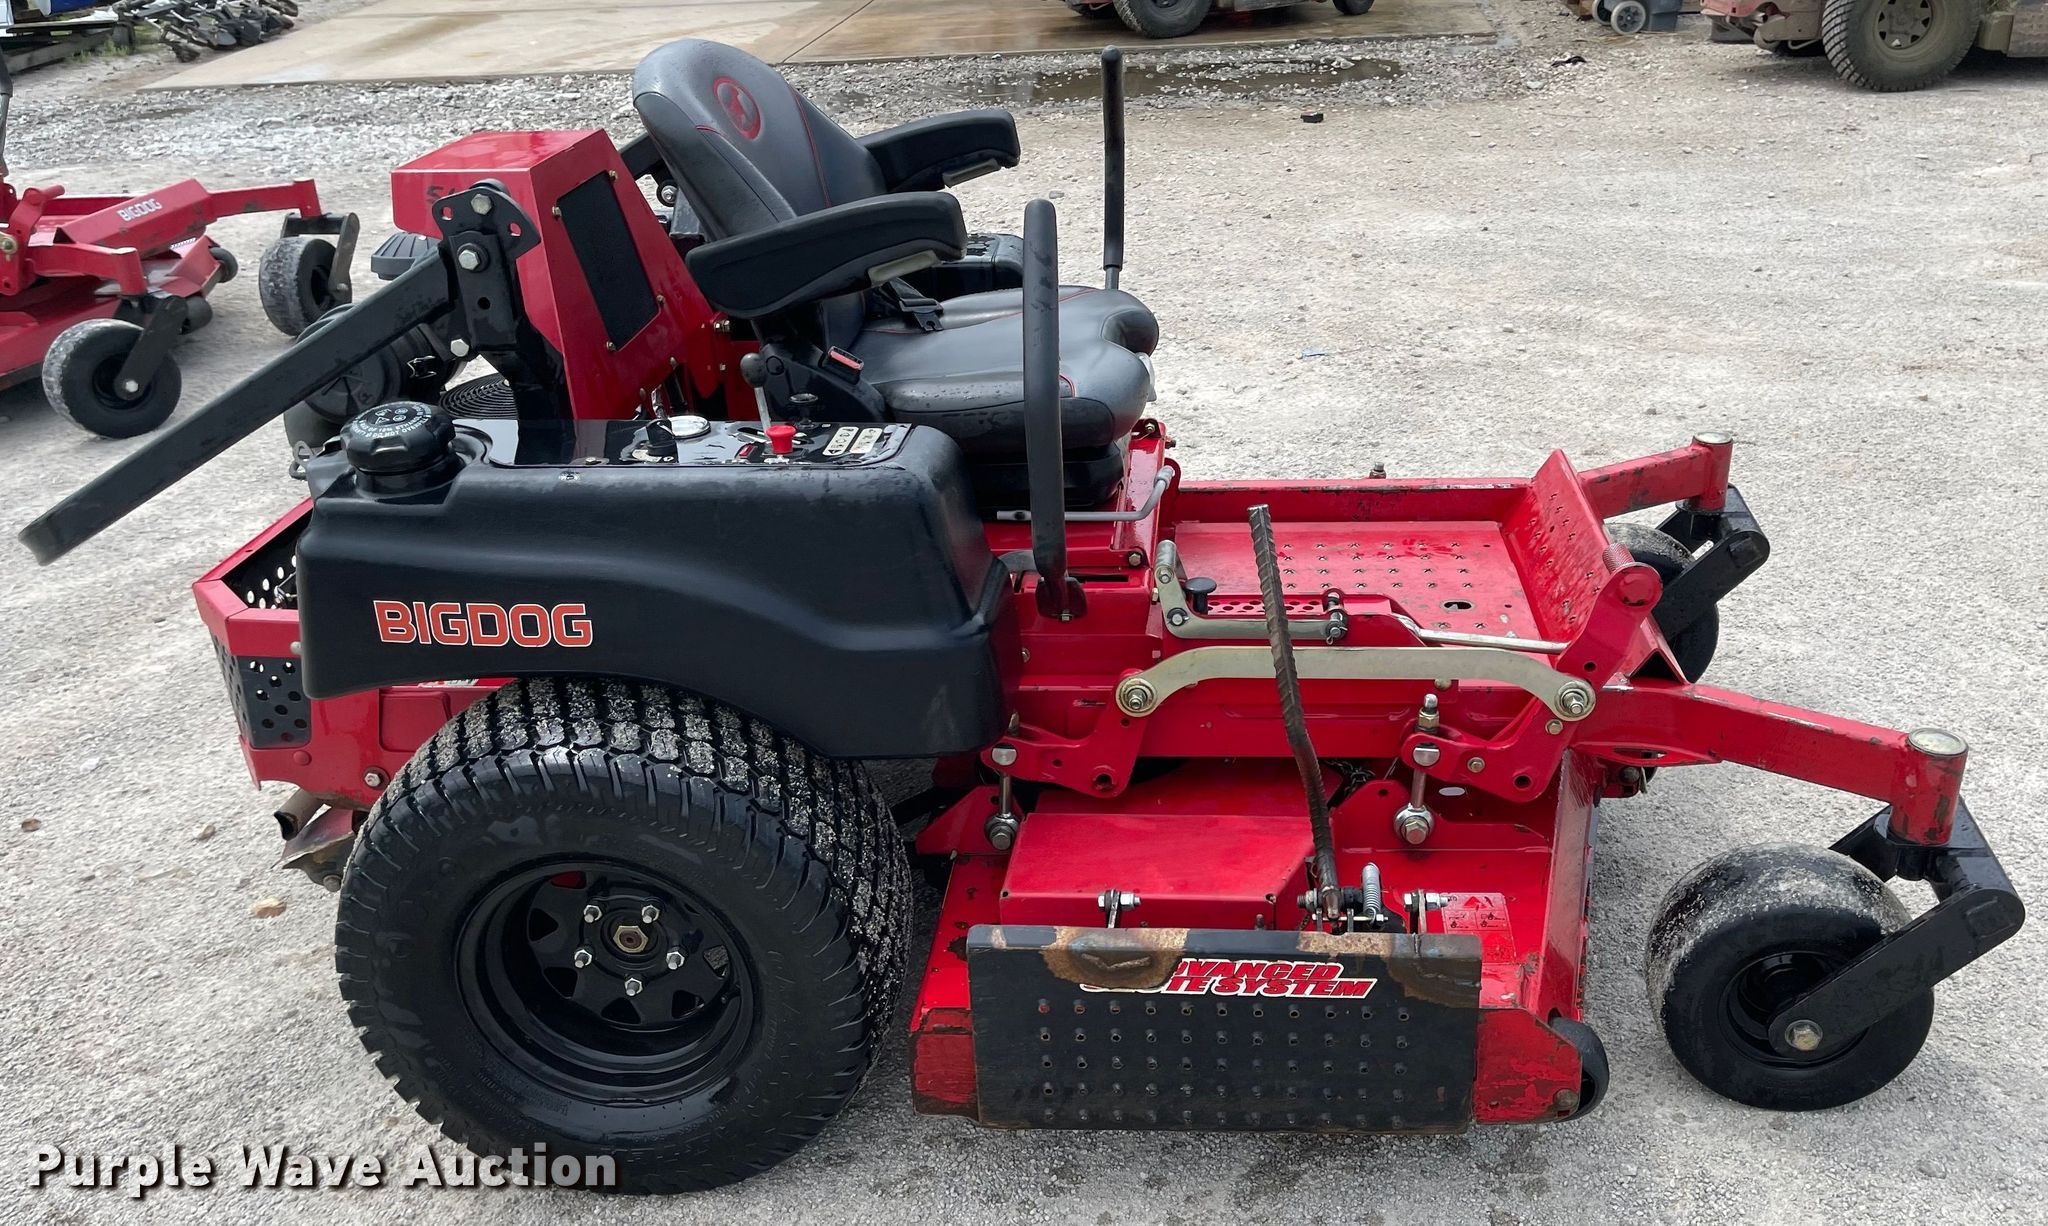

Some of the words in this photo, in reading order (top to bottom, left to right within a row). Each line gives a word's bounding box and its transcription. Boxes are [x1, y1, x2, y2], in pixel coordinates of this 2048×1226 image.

[116, 198, 162, 222] BIGDOG
[373, 600, 593, 647] BIGDOG
[1214, 977, 1375, 998] SYSTEM
